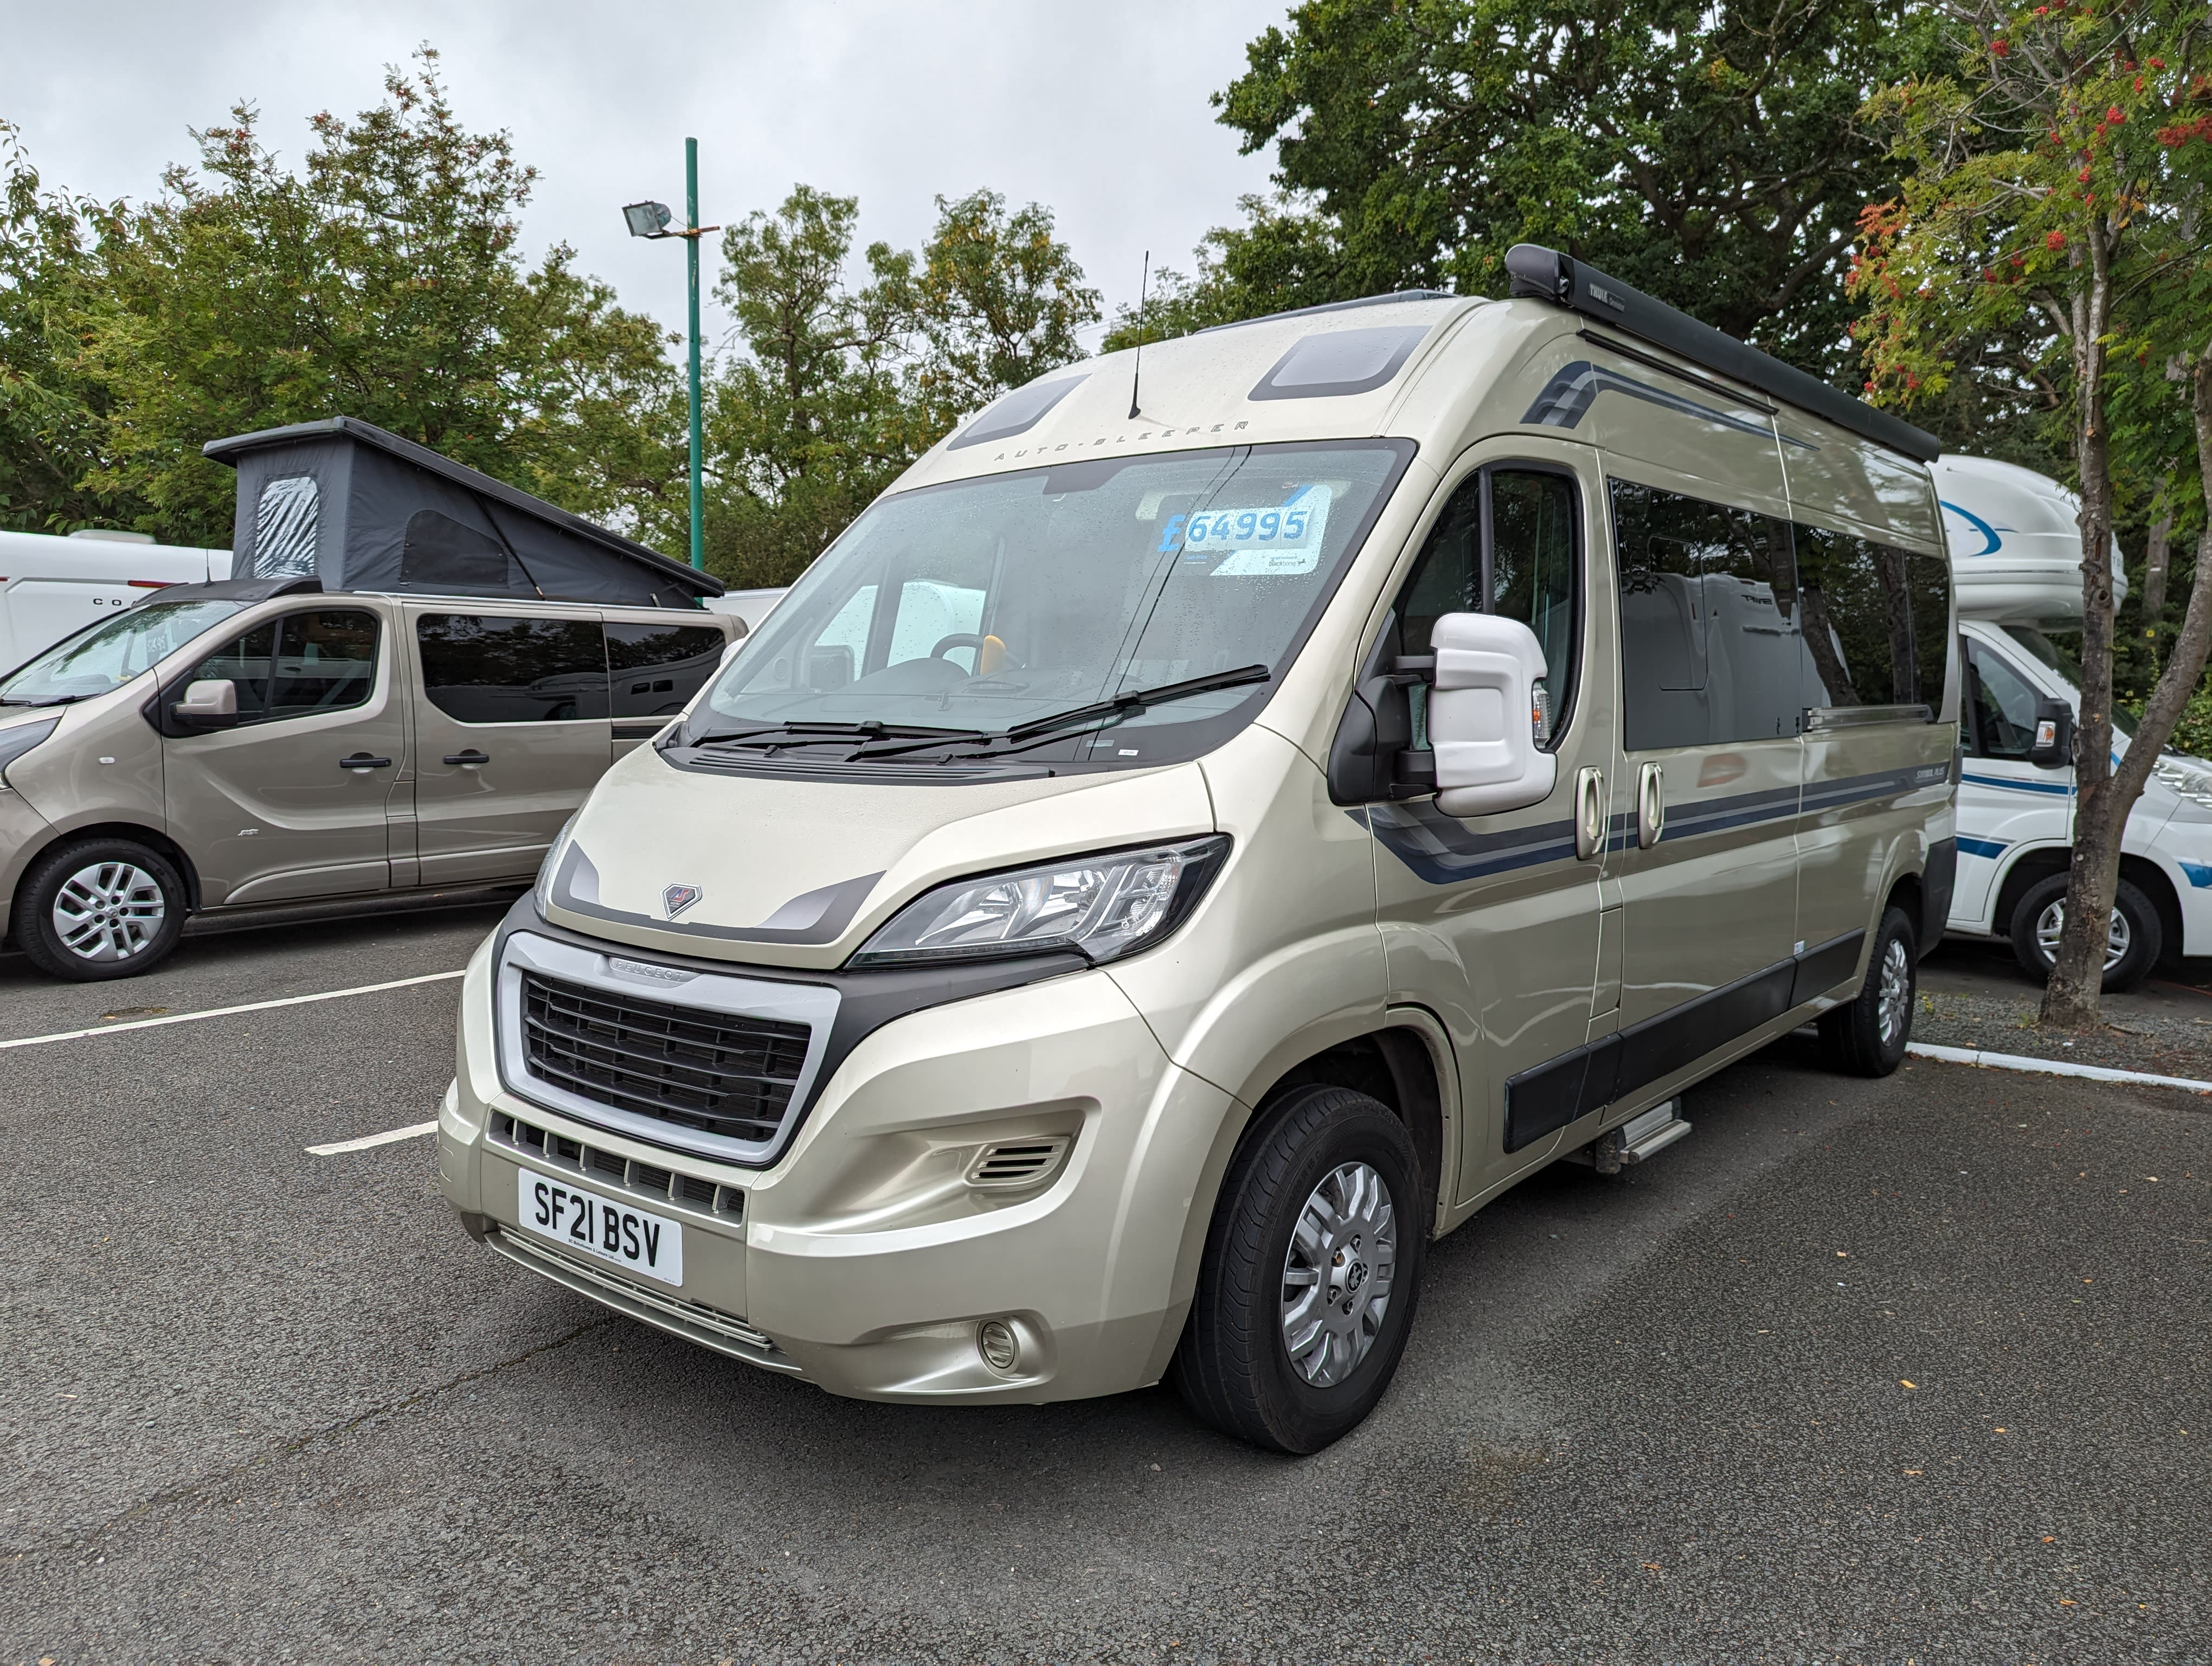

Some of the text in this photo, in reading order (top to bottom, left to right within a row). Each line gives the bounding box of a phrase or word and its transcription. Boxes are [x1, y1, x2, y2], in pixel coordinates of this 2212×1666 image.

[1589, 283, 1607, 303] THULE
[994, 421, 1249, 462] AUTO-SLEEPER
[616, 960, 684, 982] PEUGEOT
[535, 1182, 660, 1268] SF21 BSV
